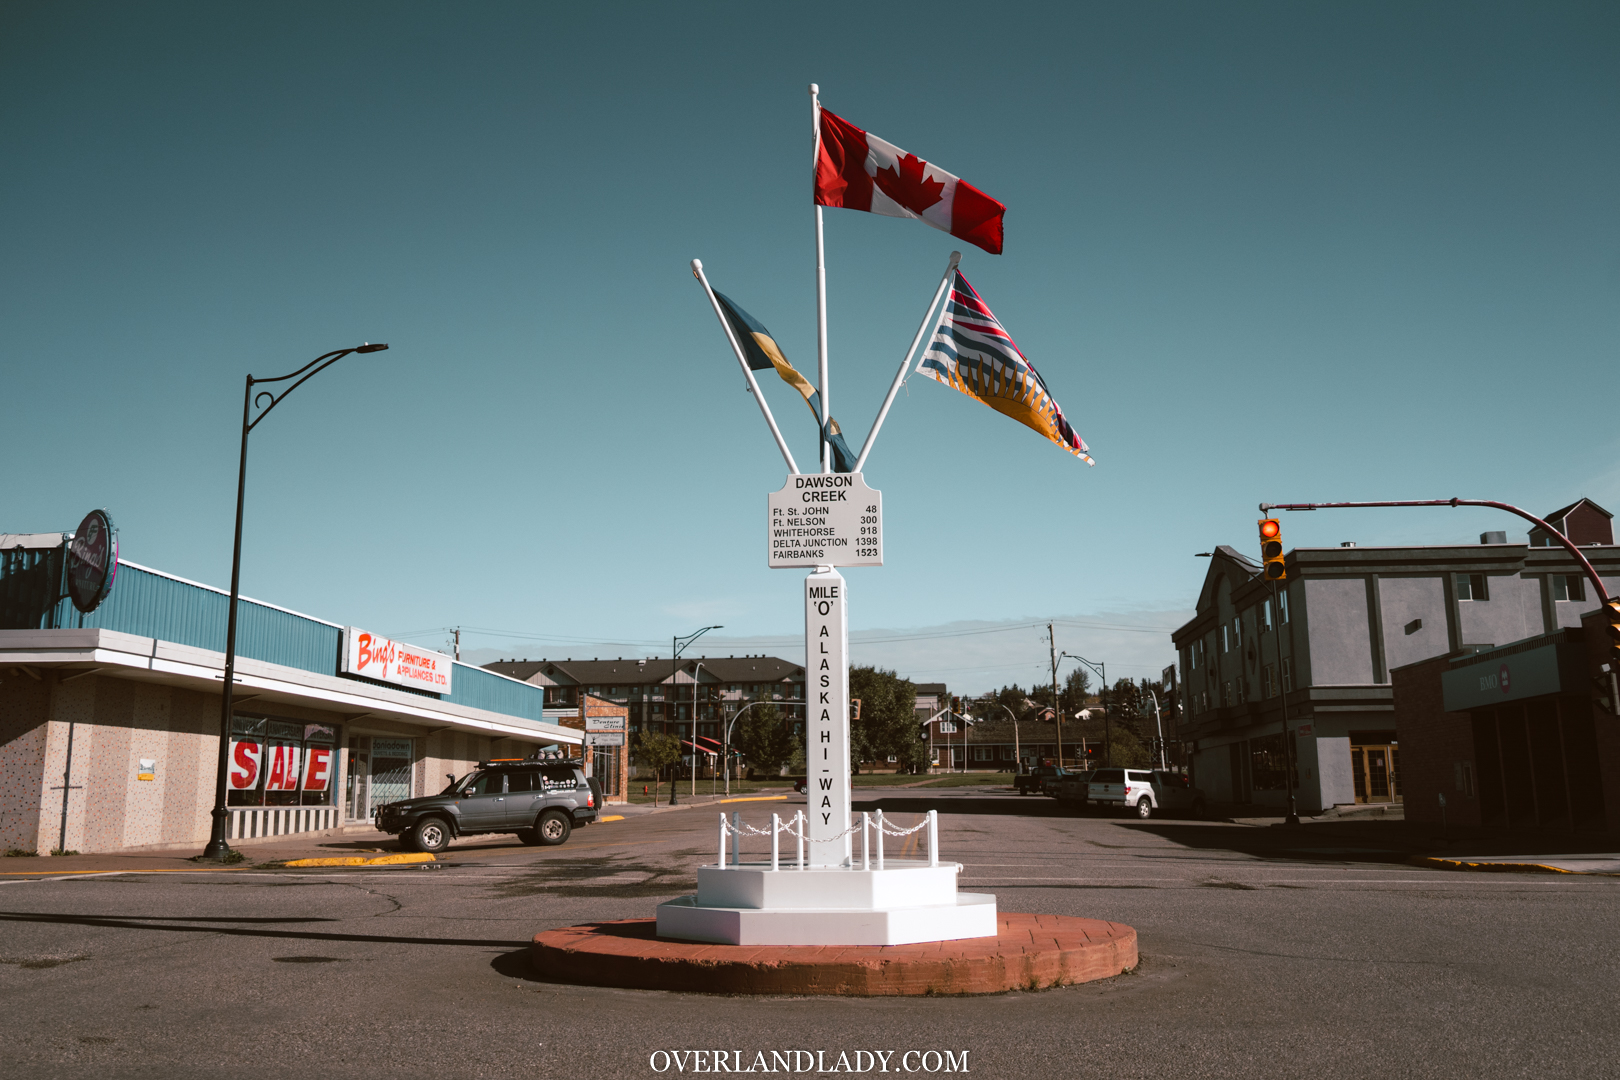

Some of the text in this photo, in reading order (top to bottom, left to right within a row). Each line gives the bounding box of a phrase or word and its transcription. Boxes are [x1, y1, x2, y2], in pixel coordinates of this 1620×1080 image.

[796, 476, 852, 488] DAWSON
[802, 490, 847, 502] CREEK
[773, 505, 877, 516] Ft. St. JOHN 48
[787, 518, 826, 526] NELSON
[860, 516, 878, 524] 300
[774, 526, 878, 538] WHITEHORSE 918
[774, 537, 878, 548] DELTA JUNCTION 1398
[71, 536, 104, 579] Bing's
[774, 548, 878, 559] FAIRBANKS 1523
[809, 586, 838, 598] MILE
[357, 633, 395, 678] Bing's
[398, 650, 436, 670] FURNITURE &
[396, 664, 448, 686] APPLIANCES LTD.
[818, 625, 830, 721] ALASKA
[1479, 674, 1498, 691] BMO
[231, 738, 330, 790] SALE
[818, 731, 833, 825] HI-WAY
